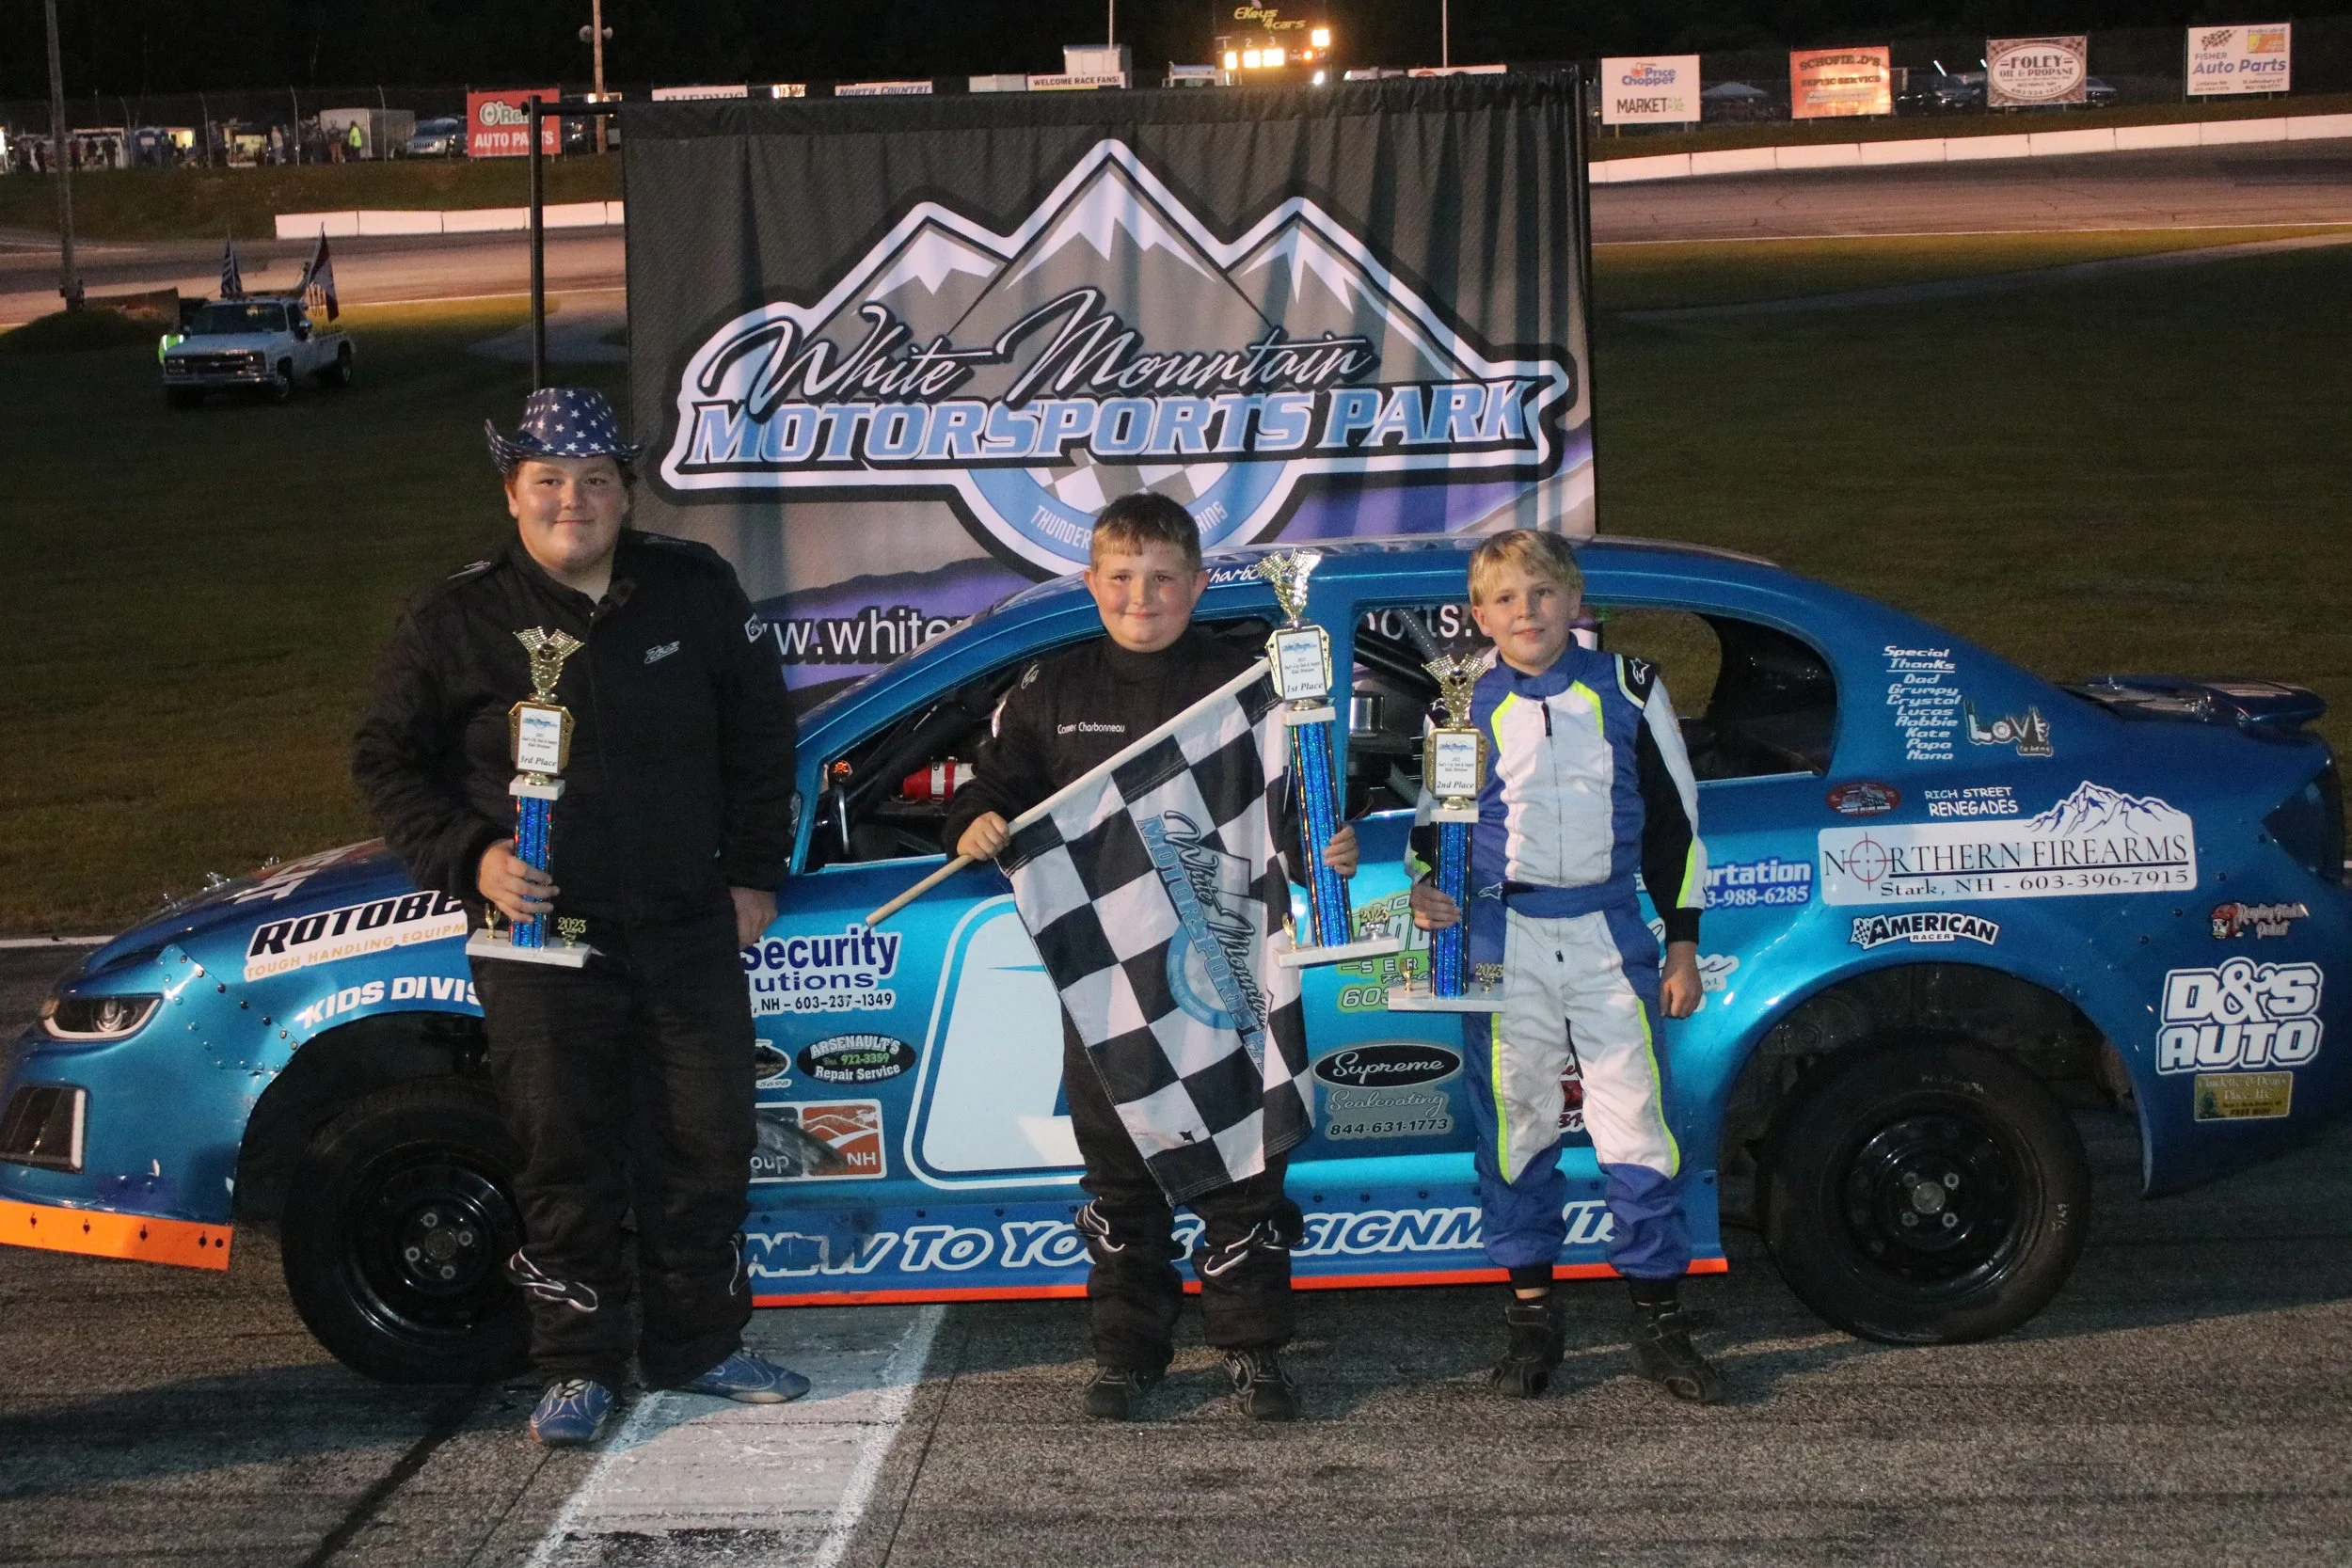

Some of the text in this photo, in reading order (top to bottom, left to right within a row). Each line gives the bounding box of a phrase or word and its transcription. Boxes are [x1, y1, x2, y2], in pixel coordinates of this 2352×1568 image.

[1245, 38, 1252, 47] 2
[2010, 55, 2062, 69] FOLEY
[2192, 58, 2286, 74] Auto Parts
[1645, 67, 1677, 76] Price
[1033, 75, 1120, 86] WELCOME RACE FANS!
[1621, 75, 1676, 87] Chopper
[1837, 75, 1881, 85] SERVICE
[839, 85, 930, 96] NORTH COUNTRY
[1616, 97, 1667, 113] MARKET
[474, 131, 554, 148] AUTO PATS
[701, 288, 1374, 416] White Mountain
[689, 379, 1540, 465] MOTORSPORTS PARK
[1883, 645, 1950, 657] Special
[1889, 658, 1956, 671] Thanks
[1903, 673, 1940, 684] Dad
[1300, 682, 1323, 691] Place
[1887, 684, 1959, 696] Grumpy
[1886, 694, 1962, 706] Crystal
[1897, 705, 1954, 716] Lucas
[1078, 721, 1125, 733] Charbonneau
[1895, 716, 1958, 727] Robbie
[1905, 727, 1951, 738] Kate
[1906, 738, 1952, 750] Papa
[519, 755, 557, 767] 3rd Place
[1907, 749, 1954, 760] Nana
[1437, 780, 1474, 789] 2nd Place
[1925, 786, 2012, 800] RICH STREET
[1929, 799, 2019, 816] RENEGADES
[2032, 834, 2187, 867] FIREARMS
[1881, 879, 1946, 896] Stark,
[1954, 877, 1994, 894] NH
[2020, 869, 2189, 892] 603-396-7915
[1359, 906, 1391, 923] 2023
[557, 916, 587, 935] 2023
[1867, 914, 1996, 945] AMERICAN
[247, 956, 301, 979] TOUGH
[308, 935, 394, 964] HANDLING
[1475, 962, 1503, 977] 2023
[296, 980, 385, 1029] KIDS
[761, 997, 780, 1011] NH
[810, 1035, 900, 1059] ARSENAULT'S
[2158, 1016, 2323, 1073] AUTO
[813, 1064, 900, 1082] Repair Service
[1332, 1051, 1445, 1084] Supreme
[1329, 1089, 1445, 1118] Sealcoating
[1330, 1118, 1449, 1135] 844-631-1773
[847, 1151, 877, 1166] NH
[899, 1224, 994, 1272] TO
[1000, 1220, 1094, 1268] YO
